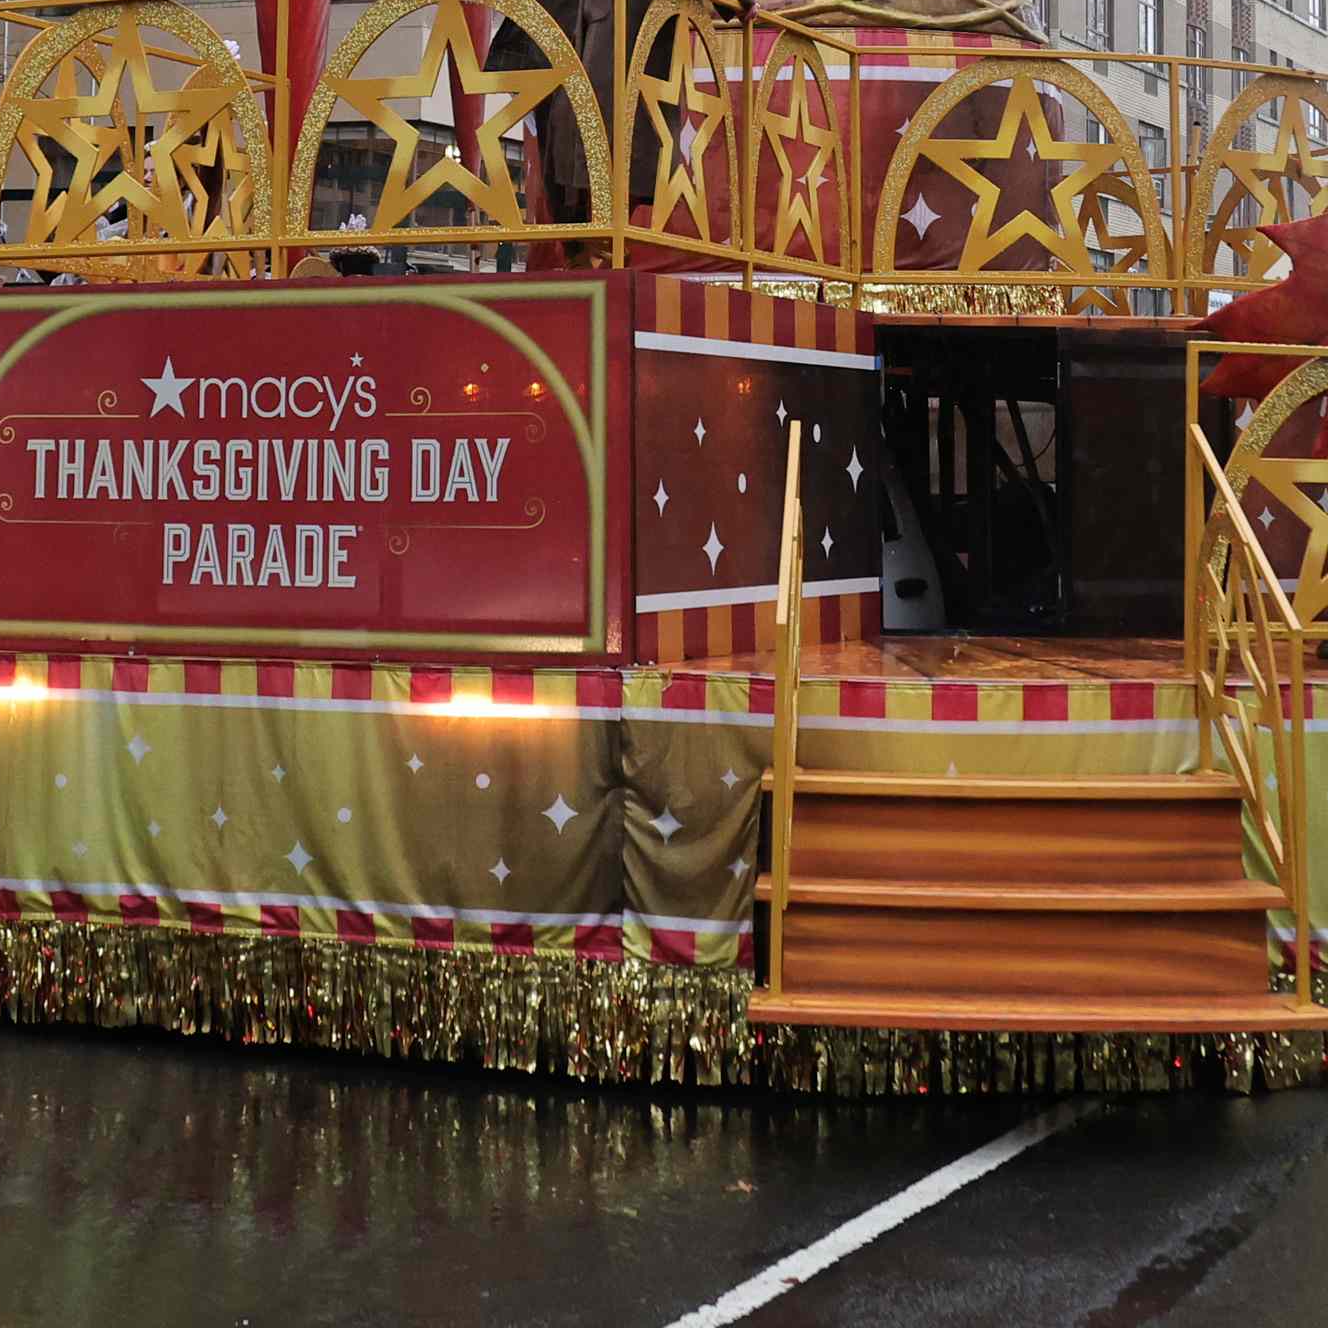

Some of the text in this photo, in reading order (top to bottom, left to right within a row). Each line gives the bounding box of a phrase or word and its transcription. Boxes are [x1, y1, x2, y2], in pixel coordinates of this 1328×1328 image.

[27, 438, 511, 502] THANKSGIVING DAY
[163, 523, 357, 588] PARADE
